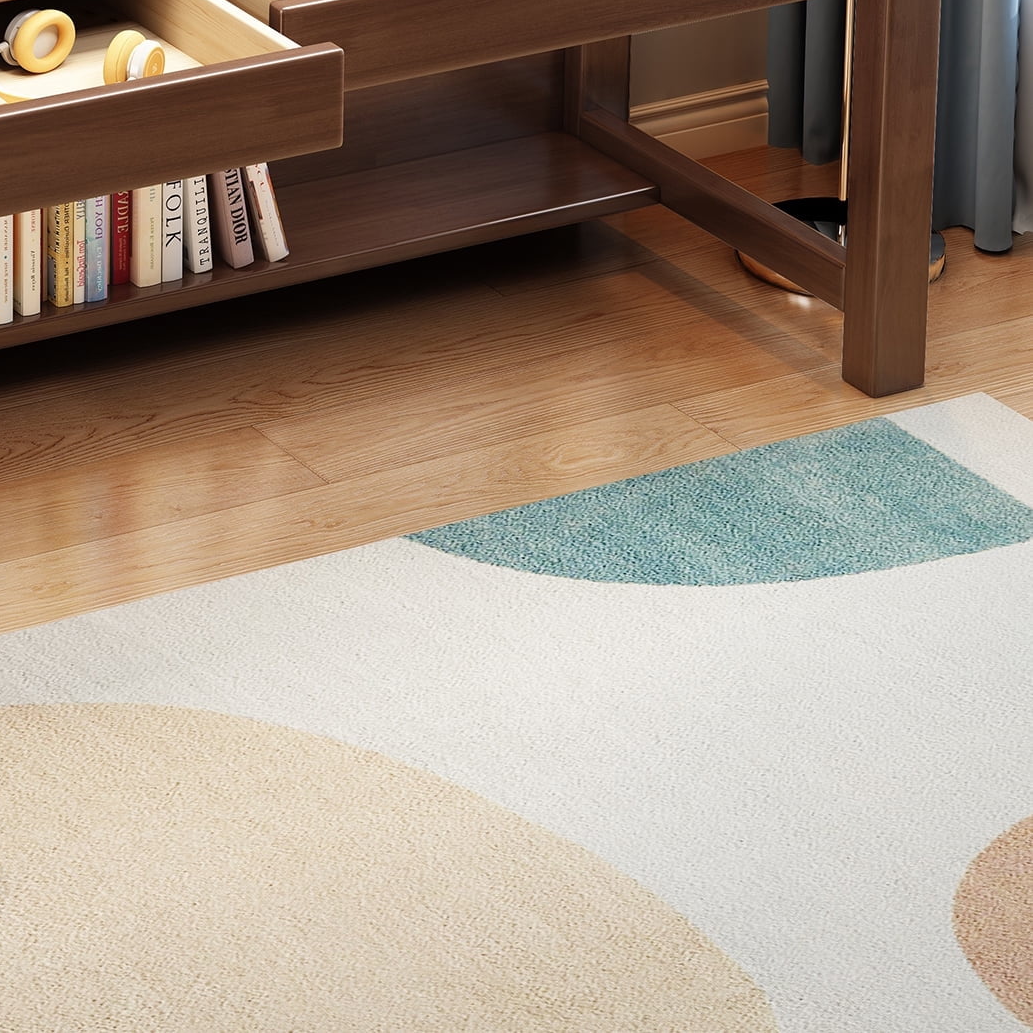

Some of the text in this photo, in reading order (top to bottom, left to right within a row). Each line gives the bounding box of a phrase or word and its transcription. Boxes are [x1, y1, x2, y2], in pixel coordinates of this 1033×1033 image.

[166, 180, 182, 247] FOLK
[194, 178, 210, 266] TRANQUILI
[231, 207, 248, 245] DIOR
